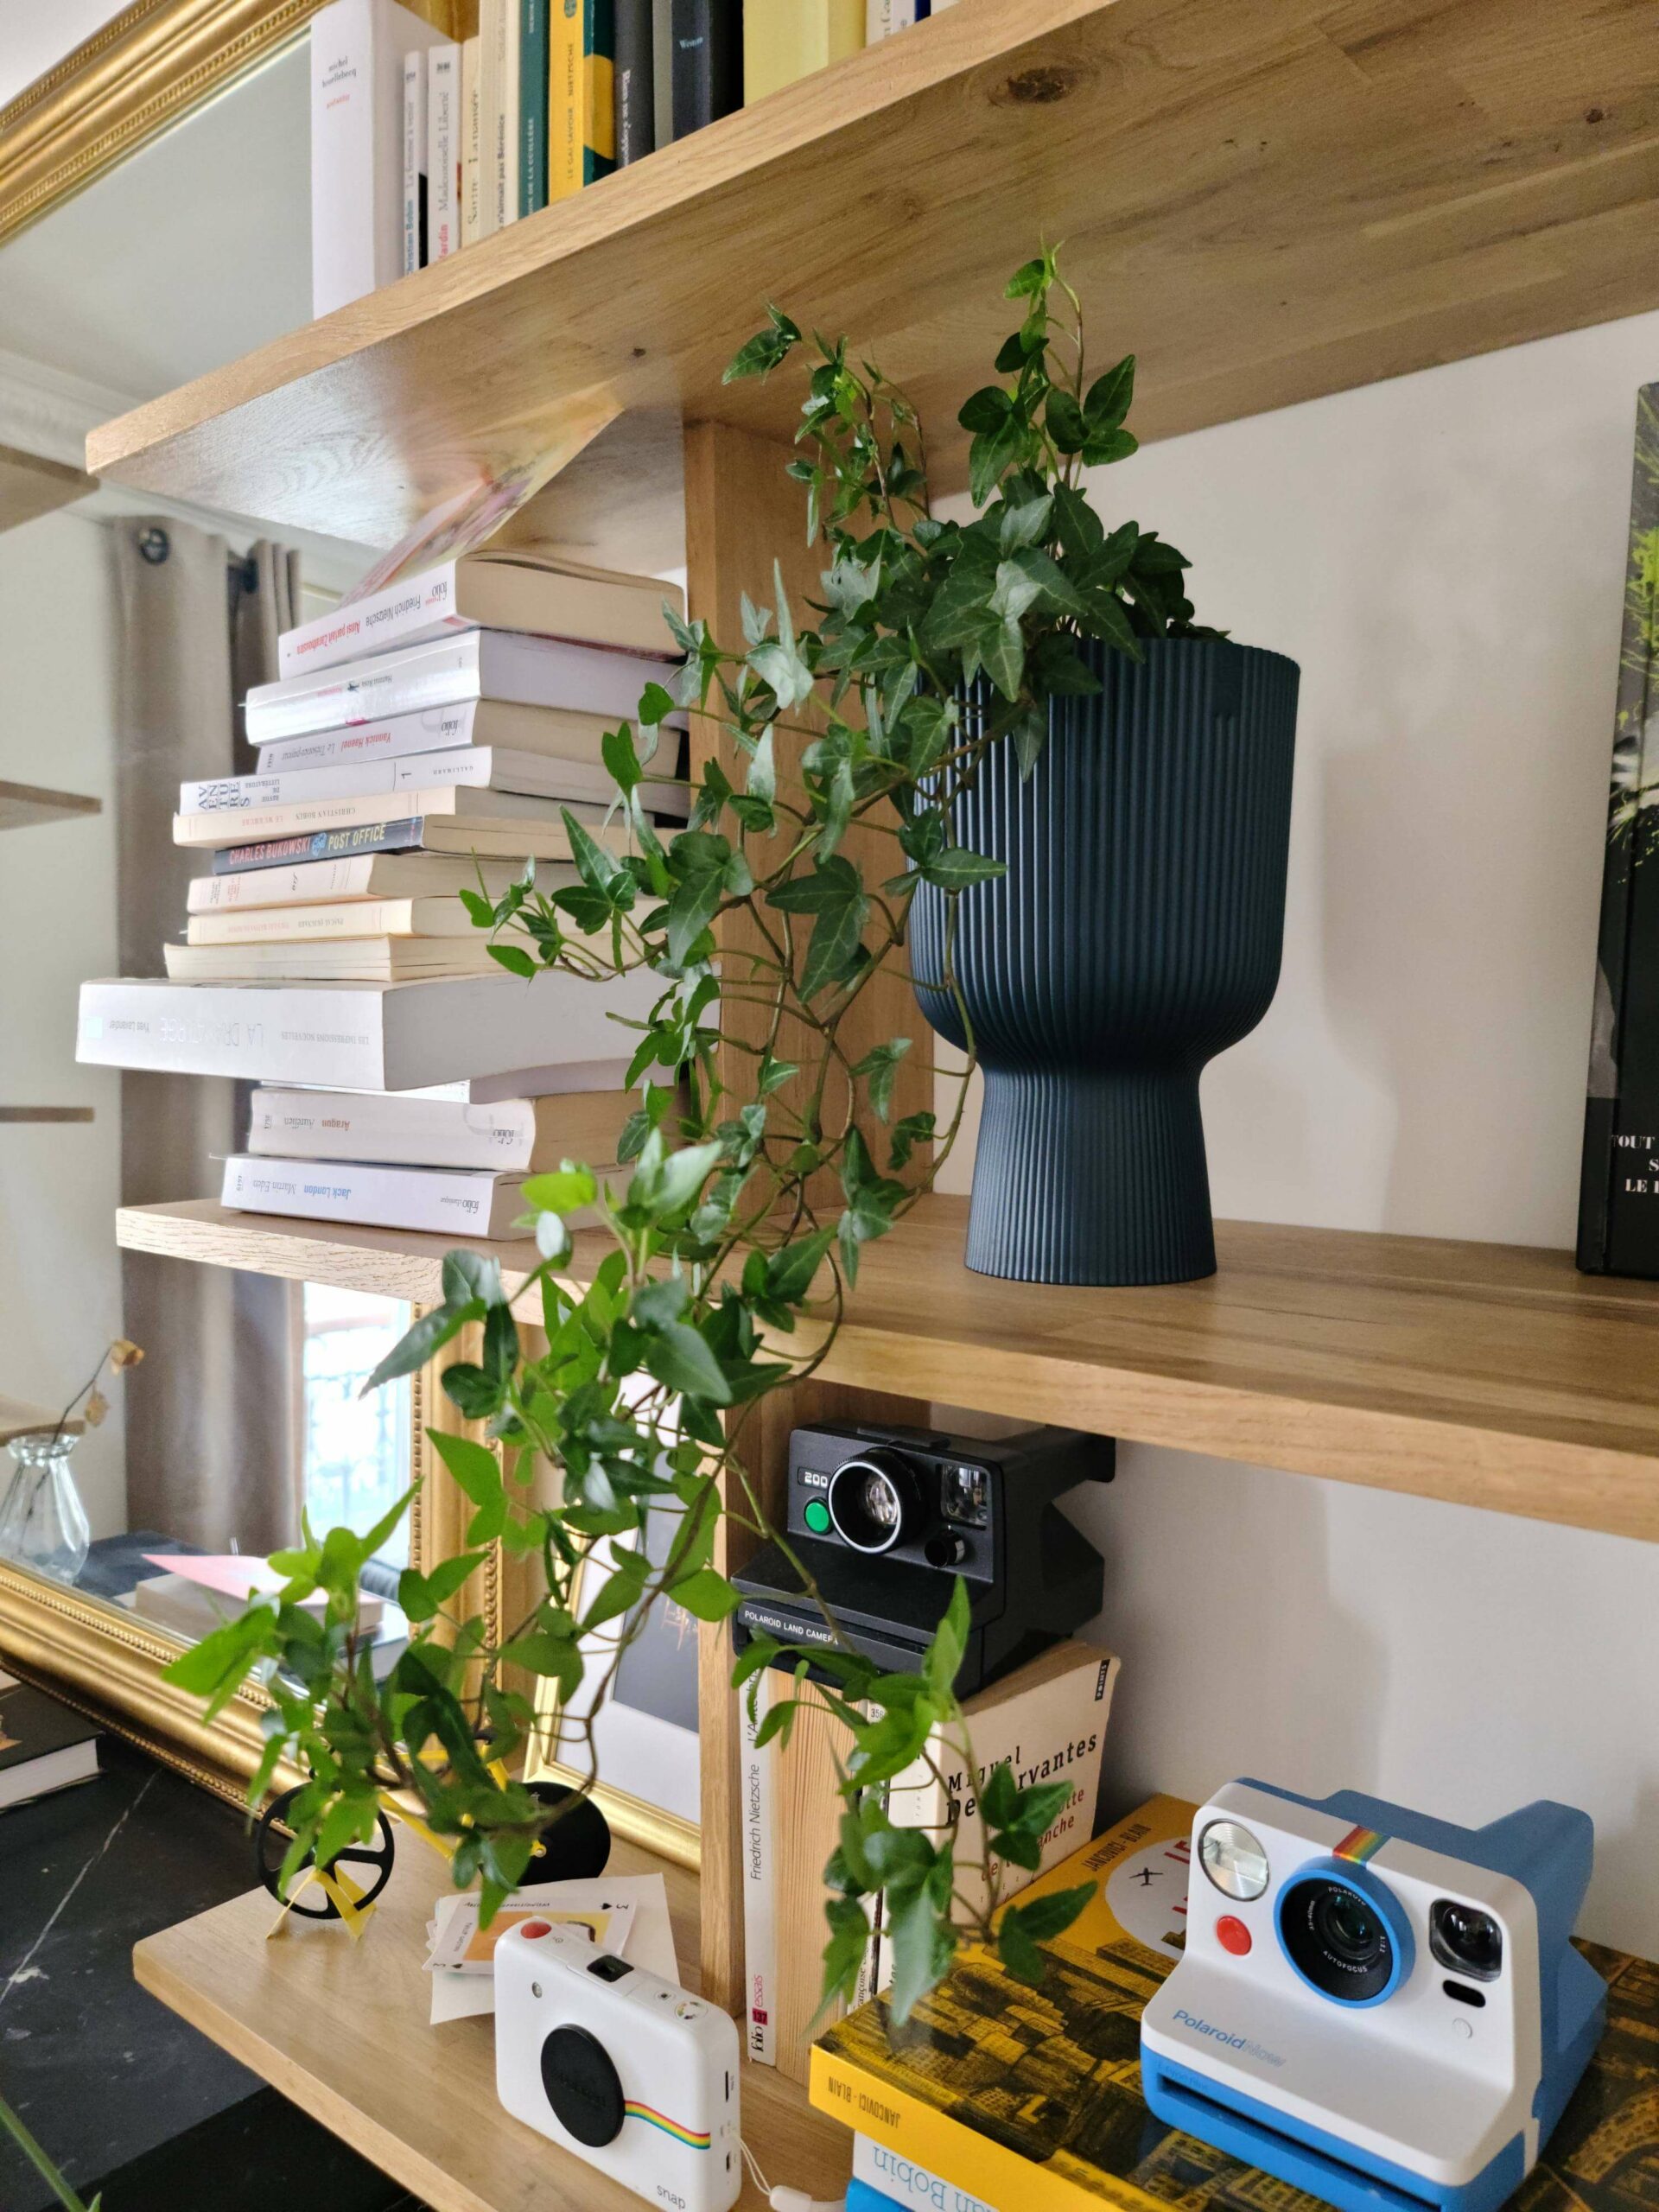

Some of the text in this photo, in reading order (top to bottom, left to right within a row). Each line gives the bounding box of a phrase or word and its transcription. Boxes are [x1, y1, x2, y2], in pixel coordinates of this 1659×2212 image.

[432, 582, 447, 601] folio
[365, 603, 394, 627] Nietzsche
[393, 594, 421, 617] Friedrich
[442, 719, 458, 735] folio
[341, 732, 391, 752] Yannick Haenel
[328, 823, 386, 851] POST OFFICE
[230, 836, 310, 865] CHARLES BUKOWSKI
[321, 1119, 351, 1131] Aragon
[1611, 1135, 1656, 1150] TOUT
[253, 1179, 297, 1195] Martin Eden
[303, 1184, 352, 1200] Jack London
[1625, 1178, 1648, 1193] LE
[462, 1199, 480, 1215] folio
[804, 1471, 829, 1489] 200
[744, 1610, 782, 1629] POLAROID
[783, 1622, 804, 1636] LAND
[1018, 1733, 1097, 1791] rvantes
[748, 1764, 762, 1881] Friedrich Nietzsche
[1082, 1823, 1152, 1872] JANCOVICI BLAIN
[1323, 1950, 1368, 1974] AUTOFOCUS
[751, 1974, 767, 2053] essais 137 folio
[1172, 2009, 1248, 2050] Polaroid
[828, 2075, 853, 2104] BLAIN
[858, 2092, 901, 2129] JANCOVICI
[873, 2145, 948, 2212] Bobin
[656, 2183, 686, 2210] snap
